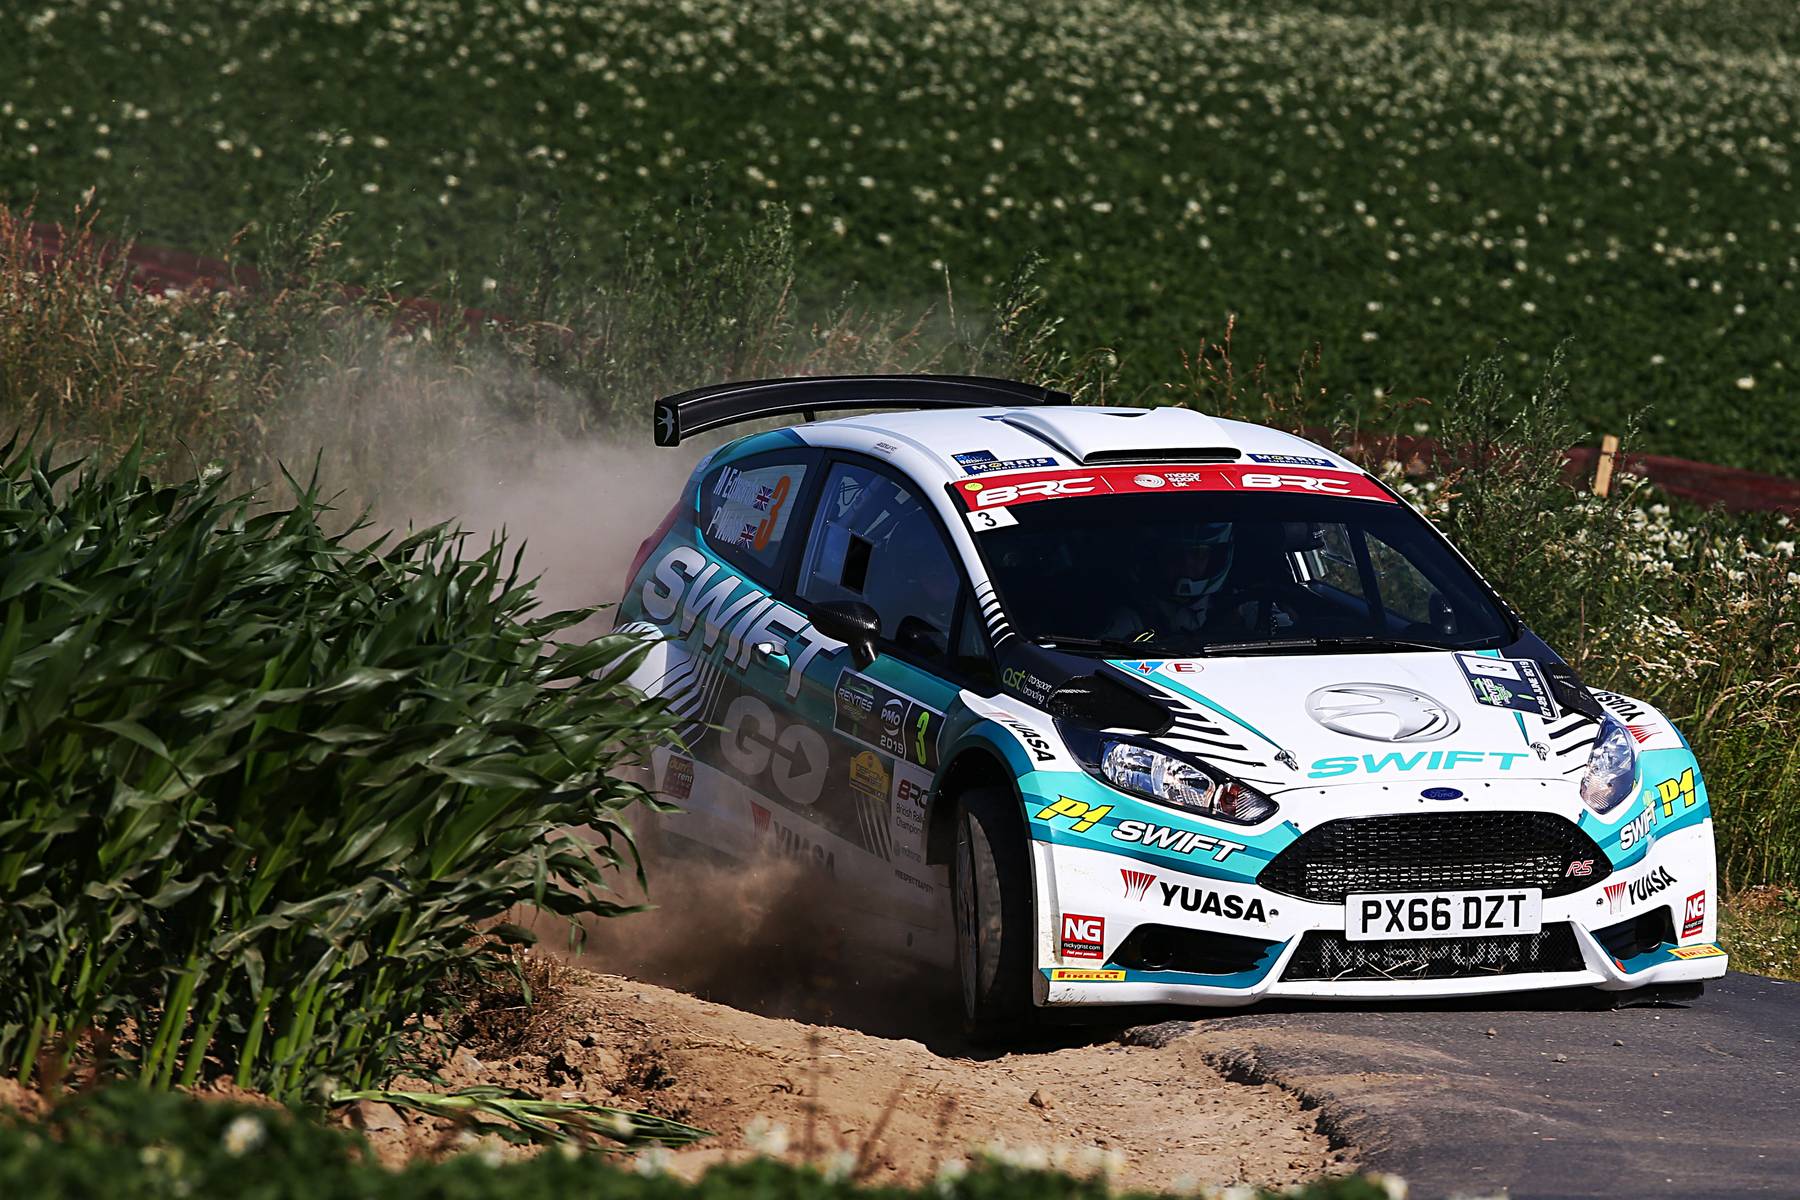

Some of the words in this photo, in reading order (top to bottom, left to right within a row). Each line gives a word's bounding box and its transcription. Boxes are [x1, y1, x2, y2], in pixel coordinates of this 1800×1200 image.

[972, 458, 1048, 471] MORRIS
[983, 463, 1042, 472] LUBRICANTS
[976, 477, 1095, 507] BRC
[1241, 473, 1351, 494] BRC
[754, 476, 791, 550] 3
[977, 512, 997, 527] 3
[642, 546, 849, 698] SWIFT
[1520, 661, 1535, 677] 2019
[1528, 677, 1543, 695] JUNE
[838, 688, 874, 713] RENTIES
[1593, 691, 1646, 723] YUASA
[881, 708, 901, 726] PMO
[720, 695, 829, 805] GO
[880, 735, 904, 754] 2019
[915, 711, 930, 765] 3
[1307, 751, 1529, 779] SWIFT
[897, 779, 928, 809] BRC
[1656, 767, 1697, 818] P1
[897, 817, 922, 834] Champion
[1034, 794, 1115, 833] P1
[1620, 801, 1658, 851] SWIFT
[1111, 819, 1247, 863] SWIFT
[1565, 859, 1595, 877] RS
[1628, 865, 1678, 905] YUASA
[1160, 881, 1267, 923] YUASA
[1361, 896, 1451, 934] PX66
[1462, 894, 1527, 930] DZT
[1686, 894, 1705, 921] NG
[1064, 917, 1102, 943] NG
[1063, 942, 1101, 951] nickygrist.com
